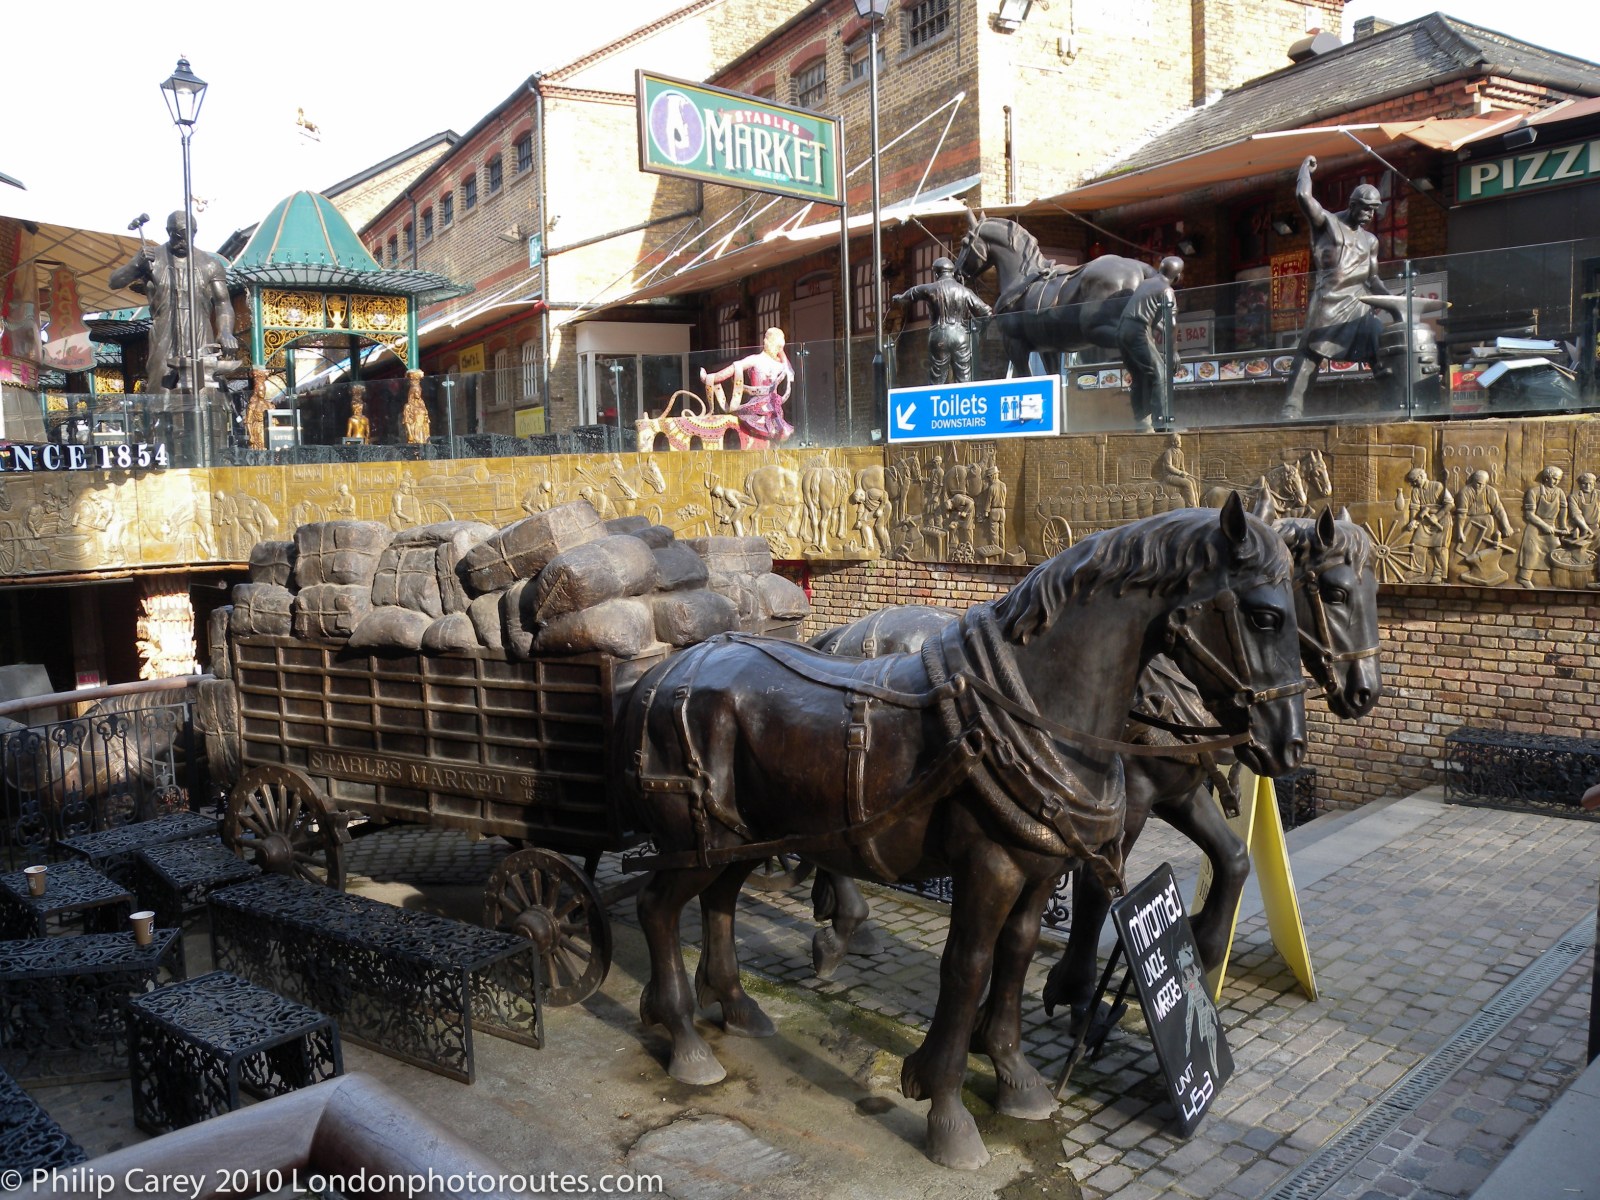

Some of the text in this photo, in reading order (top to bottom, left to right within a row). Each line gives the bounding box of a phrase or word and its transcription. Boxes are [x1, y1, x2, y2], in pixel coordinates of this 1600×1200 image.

[734, 110, 800, 136] STABLES
[703, 108, 826, 186] MARKET
[1185, 326, 1206, 342] BAR
[930, 393, 988, 417] Toilets
[931, 417, 987, 429] DOWNSTAIRS
[100, 443, 168, 468] 1854
[311, 752, 507, 795] STABLES MARKET
[1174, 1061, 1195, 1096] UNIT
[1182, 1070, 1214, 1121] 453
